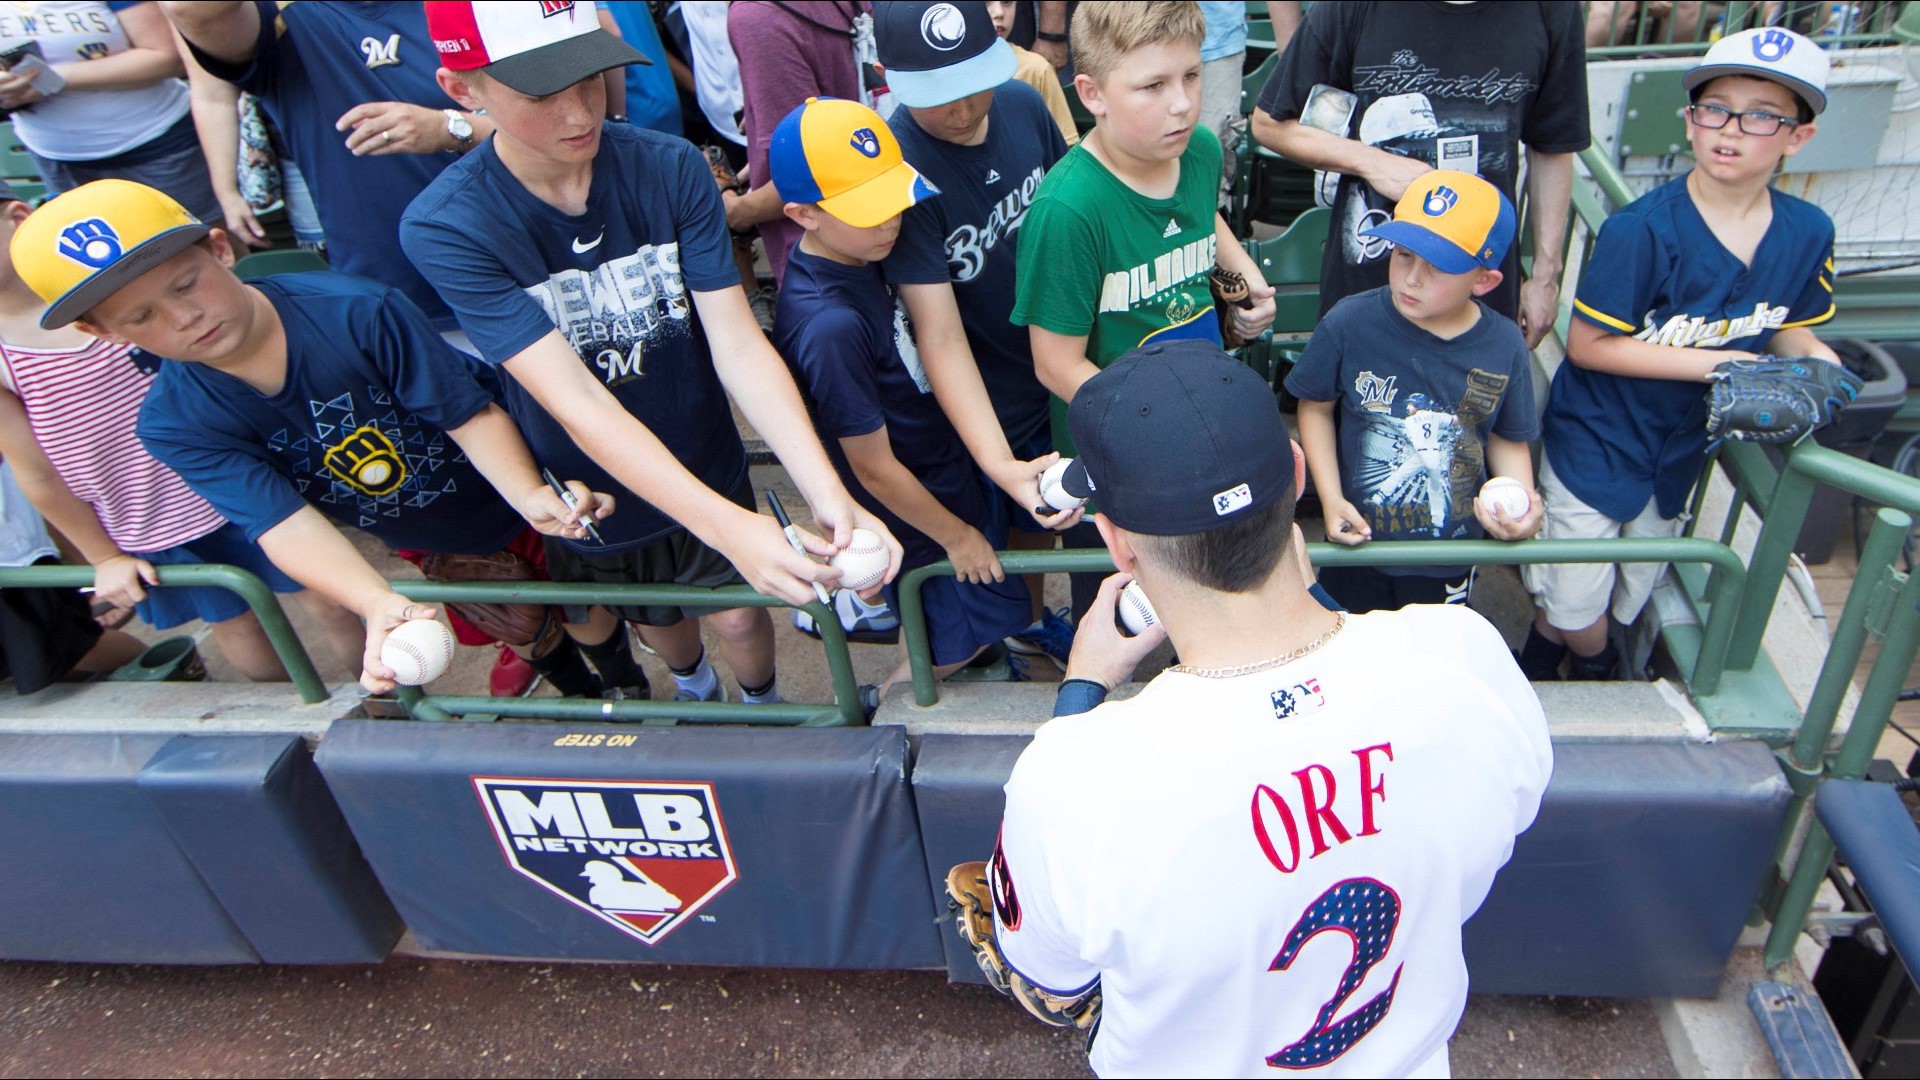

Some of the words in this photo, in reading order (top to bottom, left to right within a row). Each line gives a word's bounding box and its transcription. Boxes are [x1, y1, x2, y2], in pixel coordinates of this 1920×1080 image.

[0, 11, 111, 38] EWERS
[360, 33, 401, 69] M
[944, 163, 1046, 282] Brewer
[1098, 233, 1217, 314] MILWAUKE
[596, 339, 647, 387] M
[1421, 422, 1433, 439] 8
[553, 734, 606, 747] STEP
[606, 734, 638, 747] NO
[493, 788, 711, 842] MLB
[1251, 741, 1394, 874] ORF
[513, 836, 719, 859] NETWORK
[1265, 876, 1405, 1070] 2
